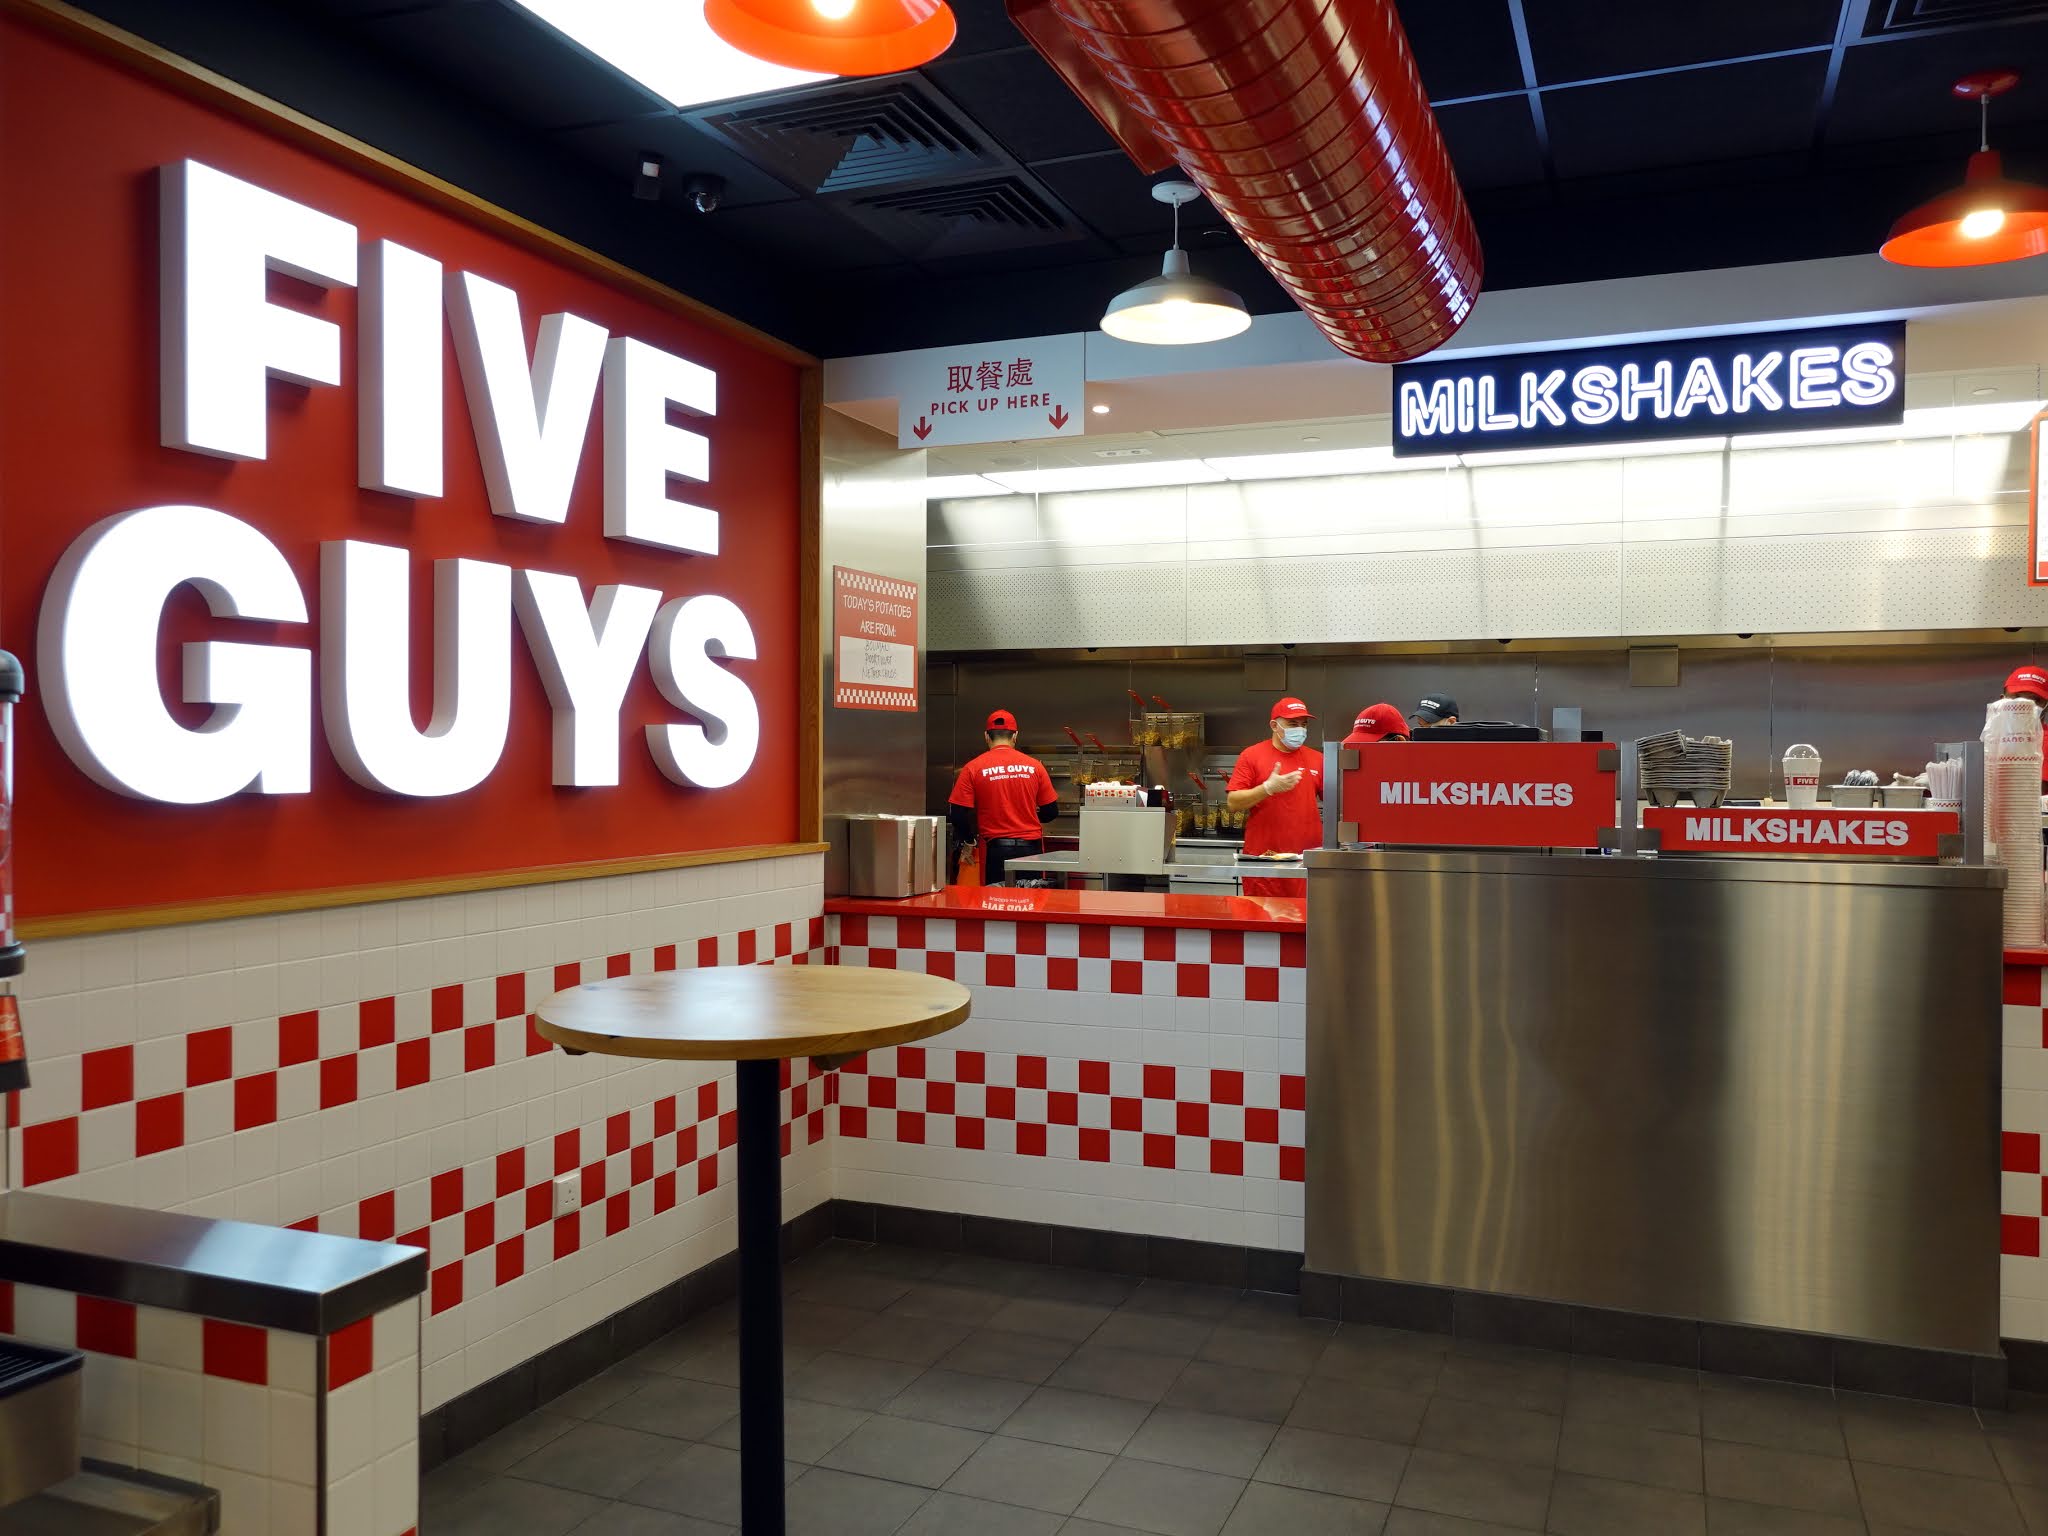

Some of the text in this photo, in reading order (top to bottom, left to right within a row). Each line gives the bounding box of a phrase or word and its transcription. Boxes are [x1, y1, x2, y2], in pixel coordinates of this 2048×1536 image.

[160, 157, 720, 556] FIVE
[946, 357, 1033, 394] 取餐處
[1400, 342, 1895, 438] MILKSHAKES
[931, 392, 1050, 416] PICK UP HERE
[843, 594, 912, 619] TODAY'S POTATOES
[860, 619, 875, 634] ARE
[36, 504, 760, 805] GUYS
[982, 764, 1035, 777] FIVE GUYS
[1380, 781, 1574, 807] MILKSHAKES
[1685, 817, 1909, 846] MILKSHAKES
